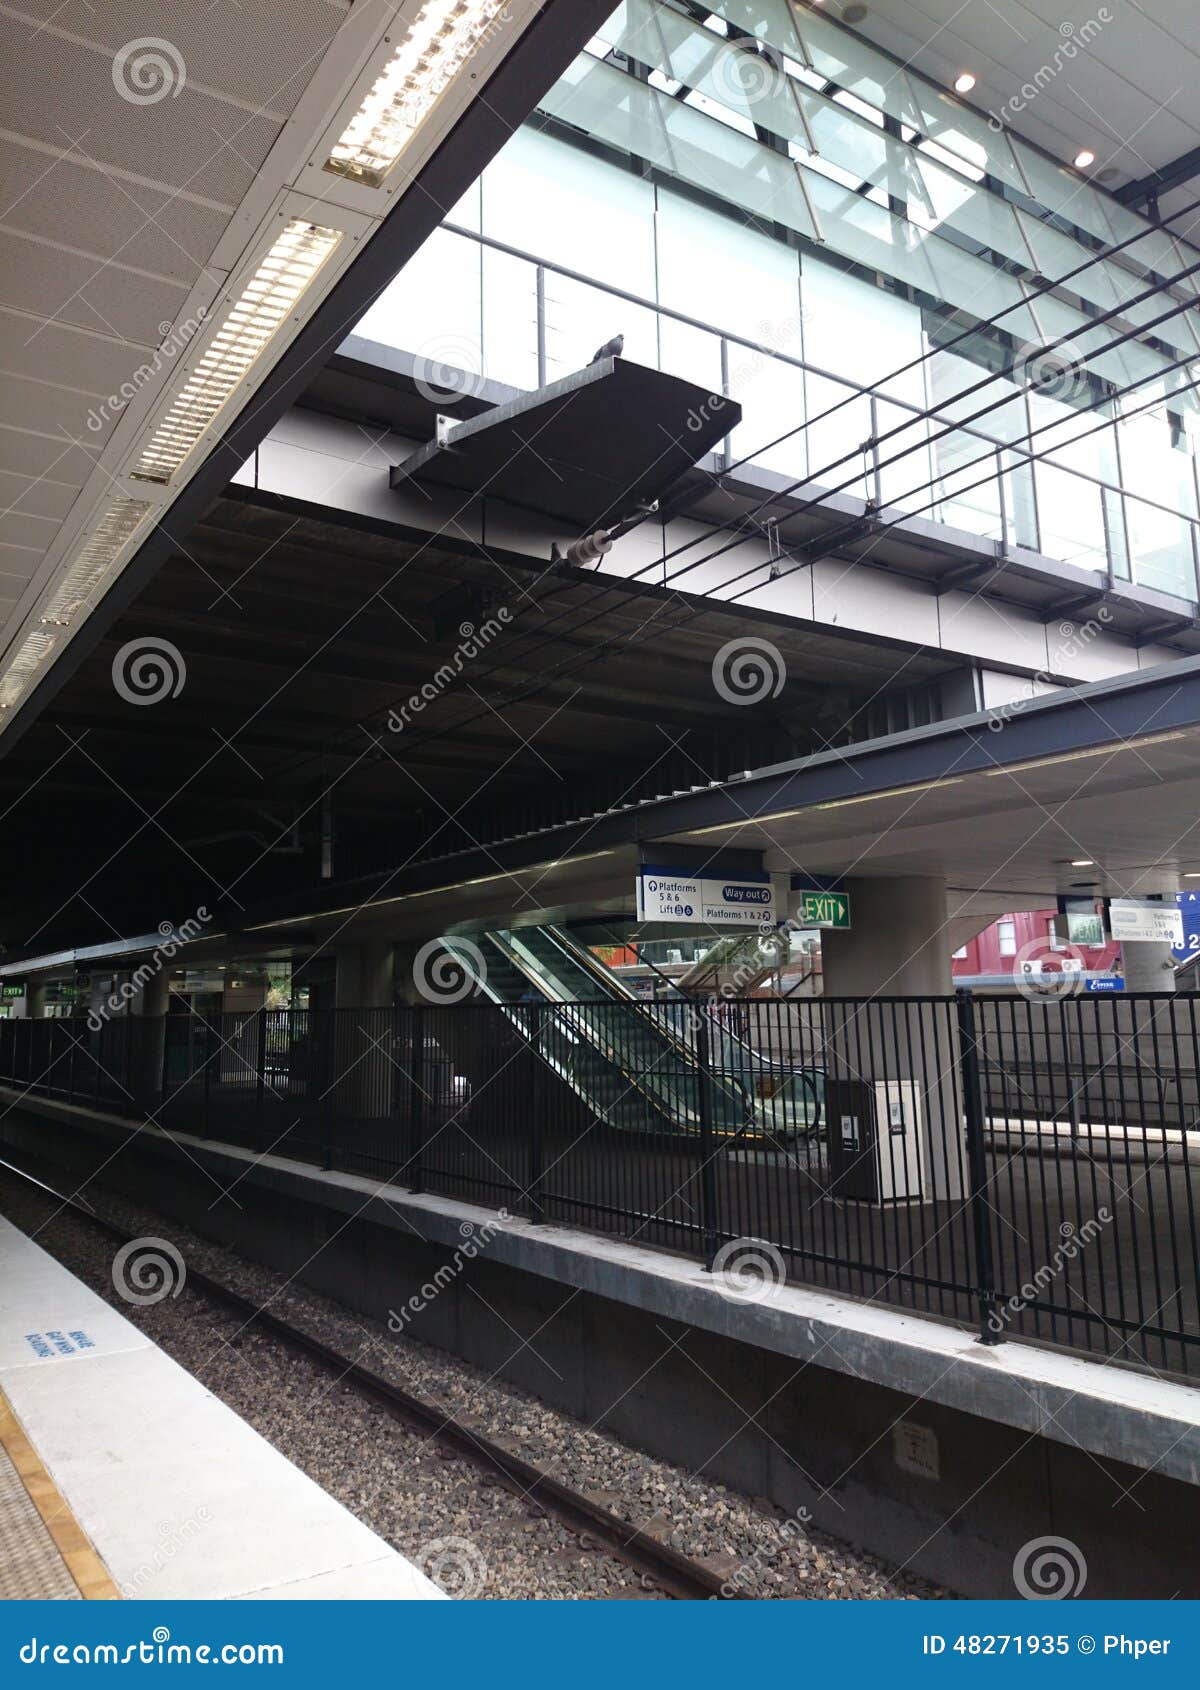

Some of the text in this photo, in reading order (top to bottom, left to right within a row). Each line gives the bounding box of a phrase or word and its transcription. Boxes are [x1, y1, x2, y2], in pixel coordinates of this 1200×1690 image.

[659, 882, 697, 892] Platforms
[660, 893, 680, 902] 5 & 6
[725, 888, 760, 900] Way out
[660, 905, 673, 914] Lift
[806, 898, 836, 920] EXIT
[706, 909, 742, 919] Platforms
[750, 911, 755, 920] &
[757, 912, 762, 920] 2
